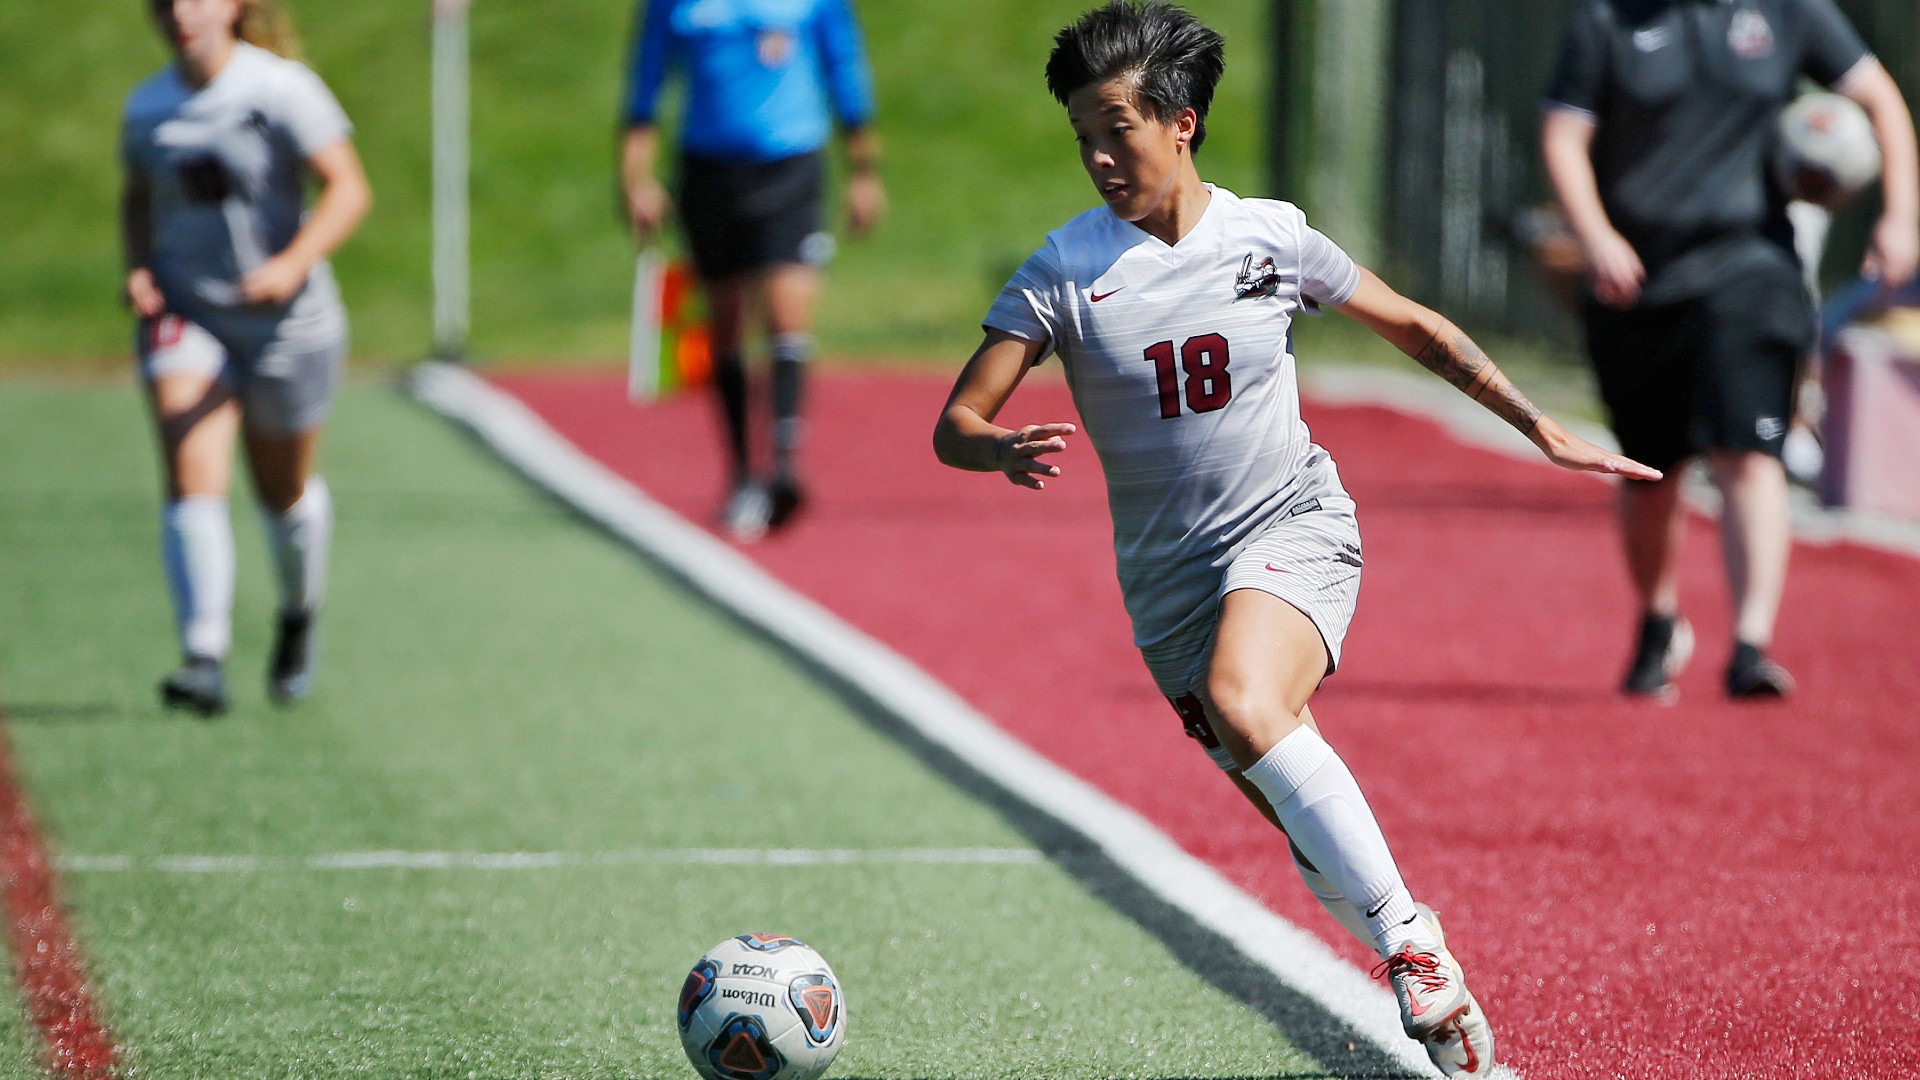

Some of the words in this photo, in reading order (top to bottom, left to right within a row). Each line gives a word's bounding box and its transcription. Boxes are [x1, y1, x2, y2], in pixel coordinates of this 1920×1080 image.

[1143, 332, 1232, 419] 18
[732, 963, 778, 980] NCAA
[721, 988, 776, 1008] Wilson
